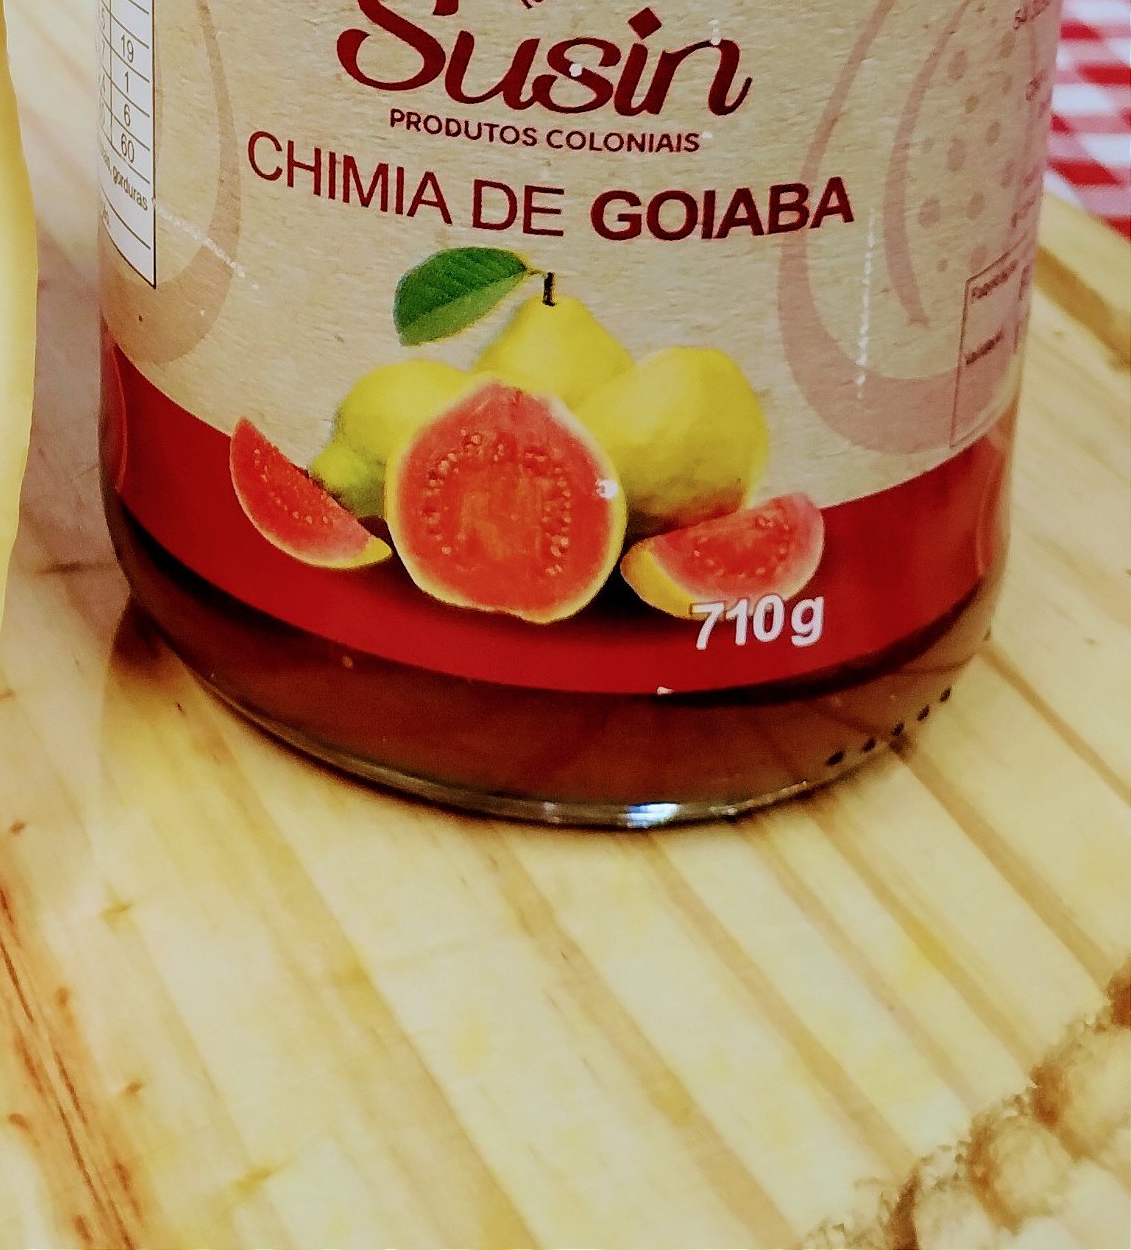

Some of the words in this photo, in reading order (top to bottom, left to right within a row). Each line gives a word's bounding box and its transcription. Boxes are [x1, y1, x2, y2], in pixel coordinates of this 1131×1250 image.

[120, 34, 135, 63] 19
[124, 71, 129, 93] 1
[123, 103, 131, 127] 6
[389, 108, 538, 148] PRODUTOS
[545, 128, 701, 154] COLONIAIS
[120, 132, 135, 163] 60
[247, 130, 454, 225] CHIMIA
[471, 178, 566, 238] DE
[589, 175, 855, 241] GOIABA
